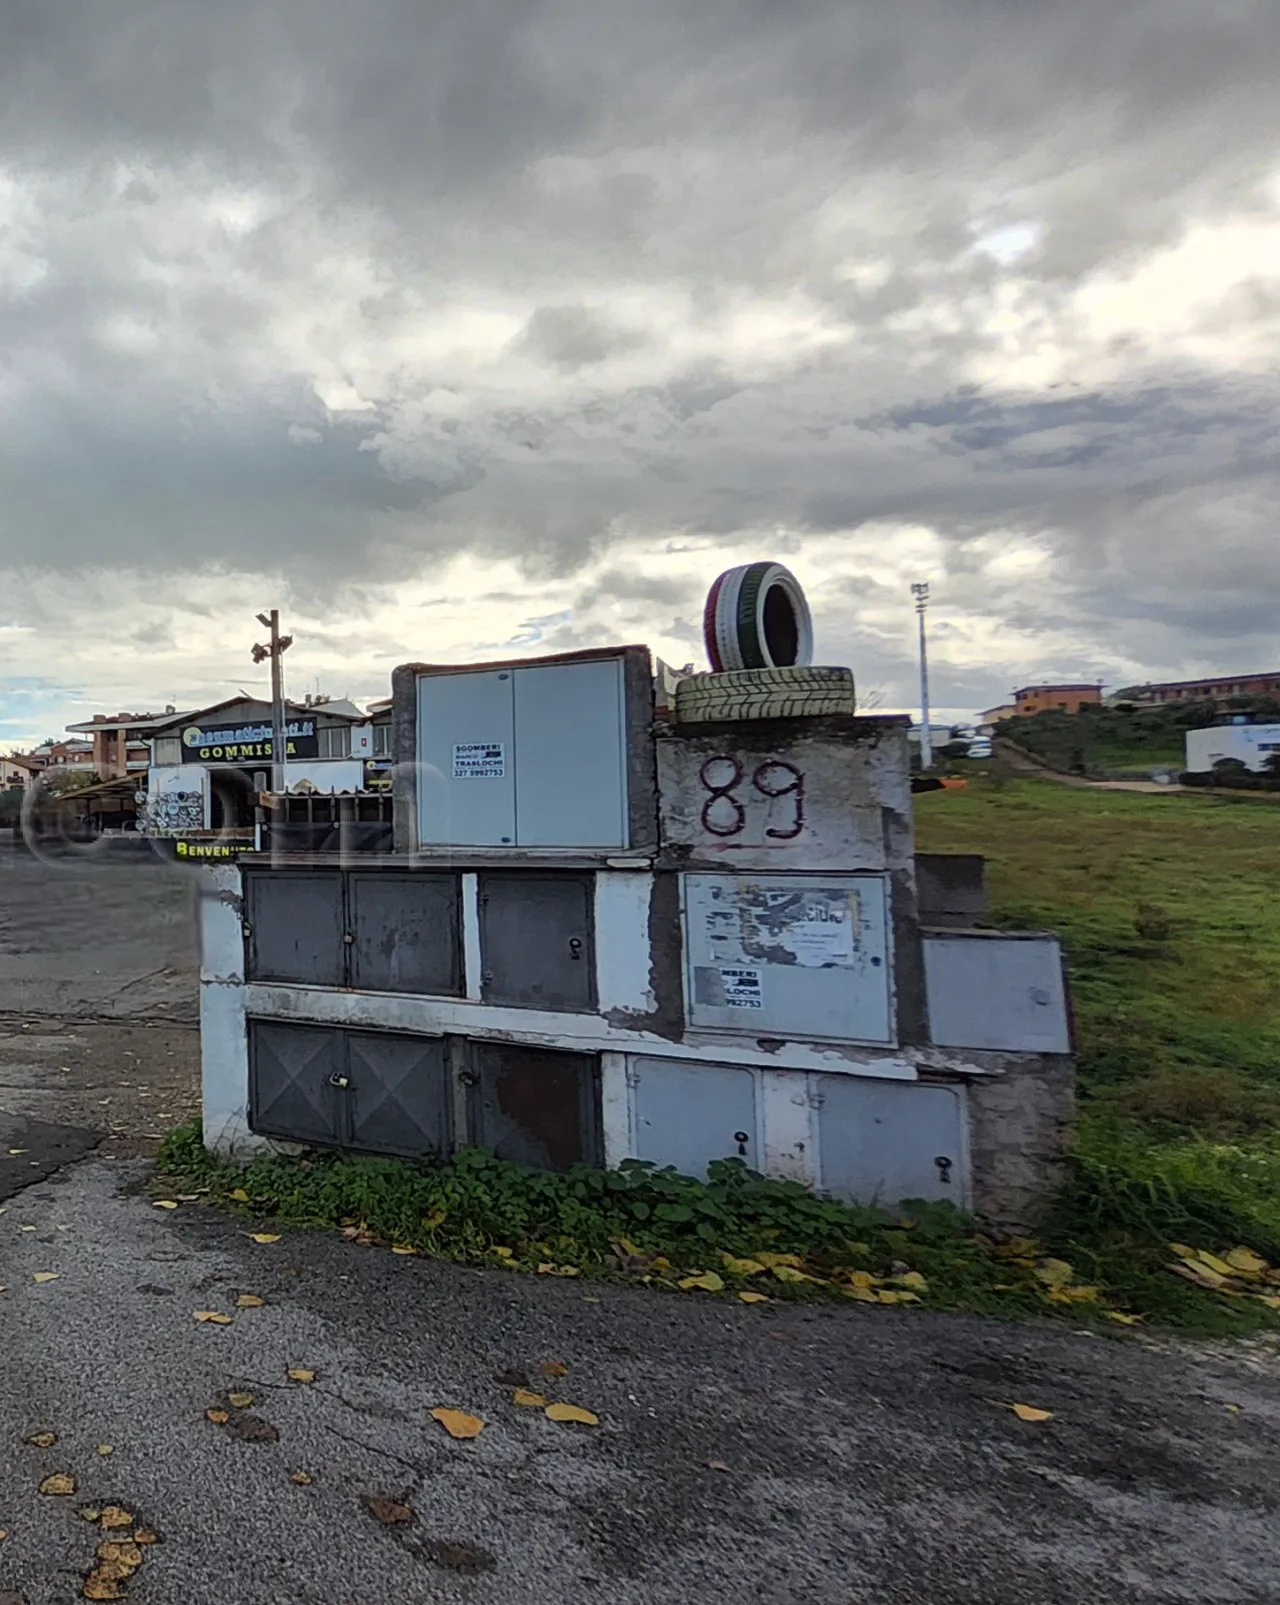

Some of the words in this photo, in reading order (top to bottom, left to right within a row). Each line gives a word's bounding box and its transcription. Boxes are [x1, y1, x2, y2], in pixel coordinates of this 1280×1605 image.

[200, 742, 297, 759] GOMMISA
[455, 744, 501, 753] SGOMBERI
[699, 755, 805, 838] 89
